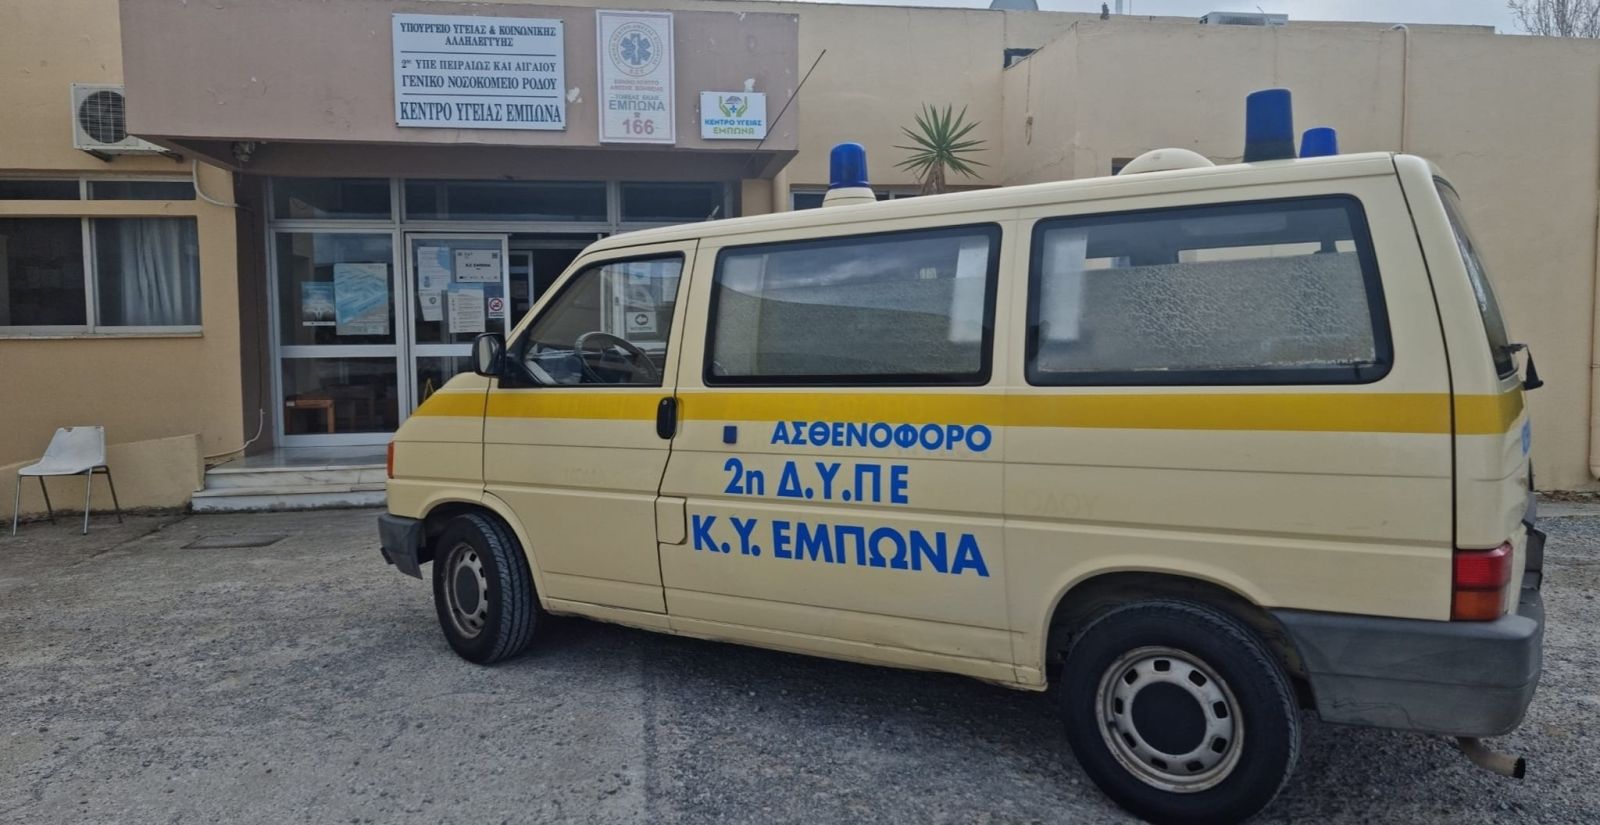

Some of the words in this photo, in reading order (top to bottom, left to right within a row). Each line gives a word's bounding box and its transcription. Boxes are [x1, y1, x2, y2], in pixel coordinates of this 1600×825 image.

[400, 23, 450, 33] ΥΠΟΥΡΓΕΙΟ
[453, 25, 486, 34] ΥΓΕΙΑΣ
[489, 25, 496, 35] &
[499, 26, 556, 36] ΚΟΙΝΩΝΙΚΗΣ
[445, 37, 513, 47] ΑΛΛΗΛΕΓΓΥΗΣ
[416, 60, 436, 69] ΥΠΕ
[440, 60, 490, 71] ΠΕΙΡΑΙΩΣ
[493, 62, 511, 71] ΚΑΙ
[515, 62, 556, 72] ΑΙΓΑΙΟΥ
[402, 75, 444, 88] ΓΕΝΙΚΟ
[448, 76, 519, 89] ΝΟΣΟΚΟΜΕΙΟ
[522, 78, 557, 90] ΡΟΔΟΥ
[400, 102, 452, 120] ΚΕΝΤΡΟ
[456, 103, 502, 121] ΥΓΕΙΑΣ
[506, 104, 561, 122] ΕΜΠΩΝΑ
[609, 100, 665, 111] ΕΜΠΩΝΑ
[622, 118, 654, 135] 166
[770, 421, 992, 452] ΑΣΘΕΝΟΦΟΡΟ
[692, 514, 761, 557] Κ.Υ.
[772, 520, 990, 577] ΕΜΠΩΝΑ
